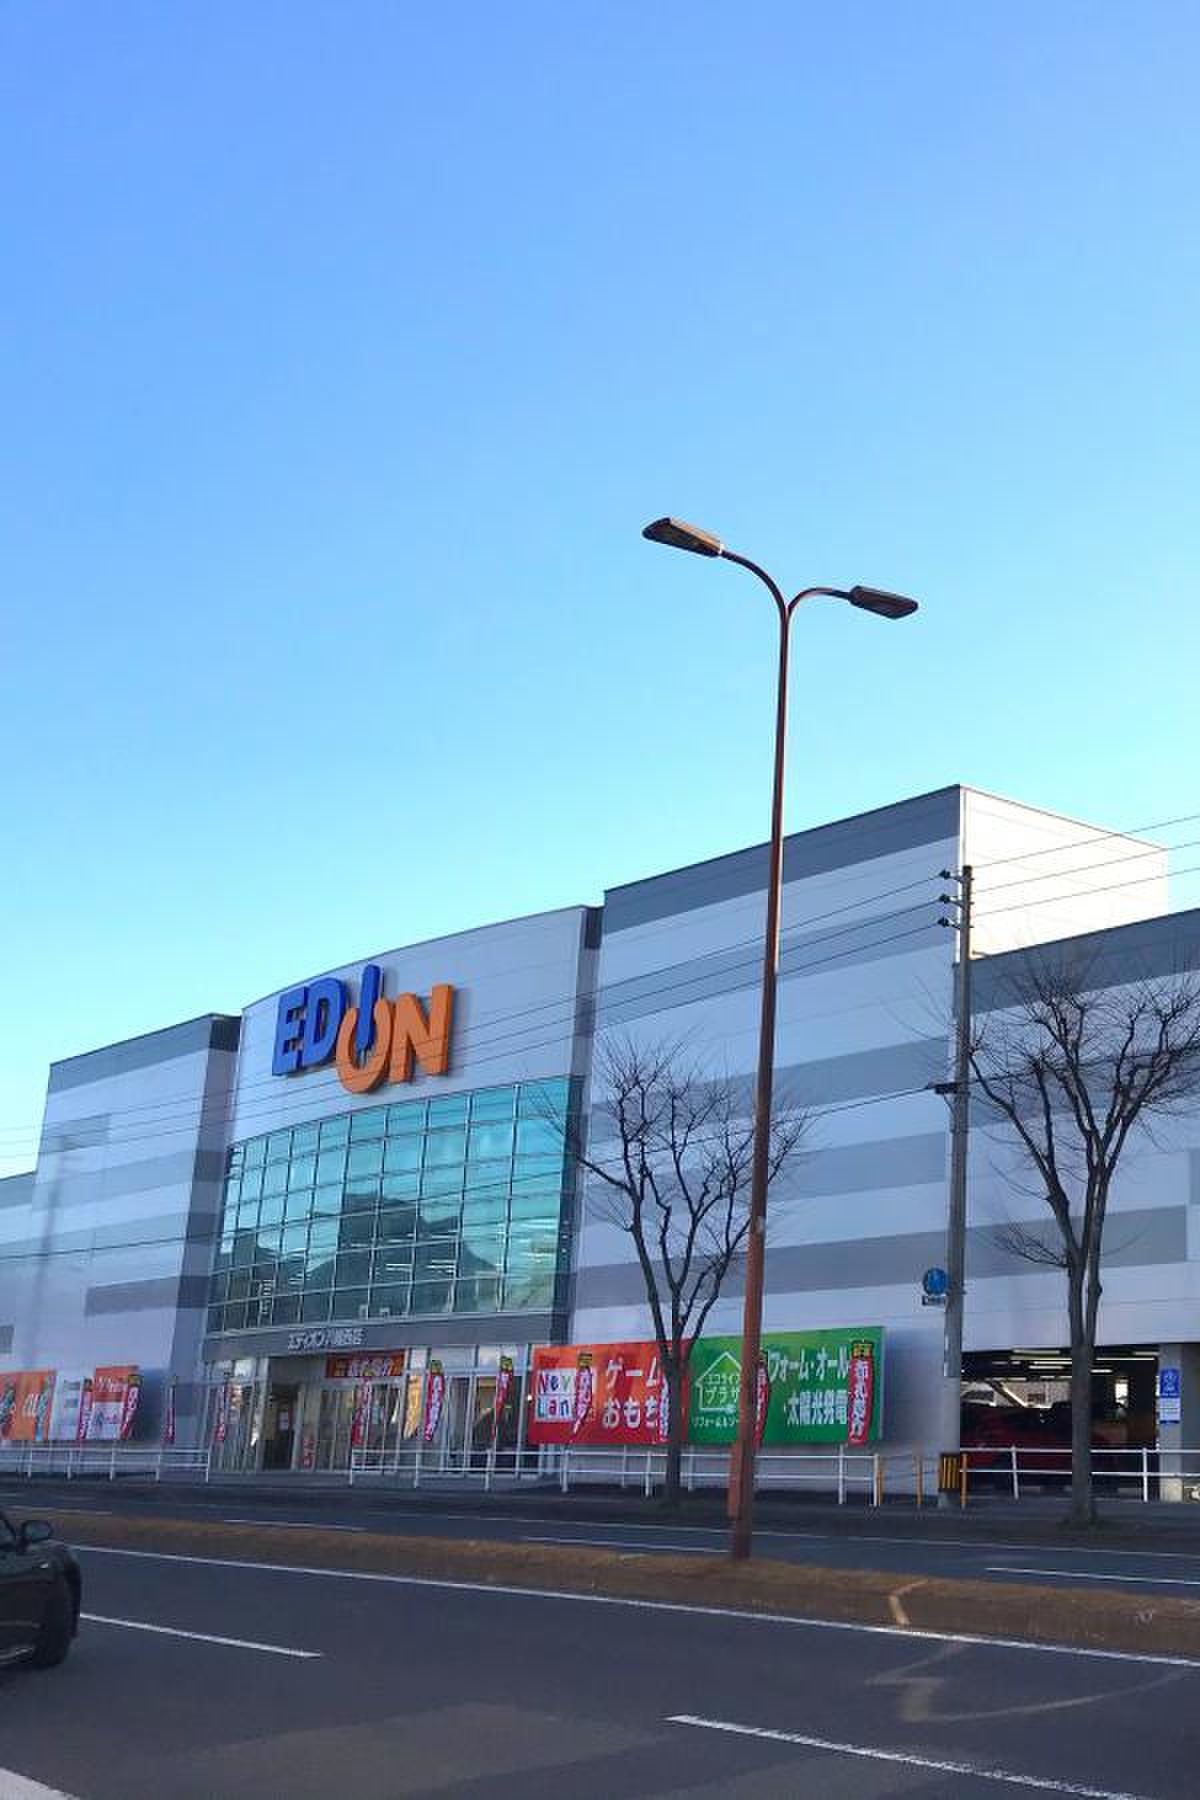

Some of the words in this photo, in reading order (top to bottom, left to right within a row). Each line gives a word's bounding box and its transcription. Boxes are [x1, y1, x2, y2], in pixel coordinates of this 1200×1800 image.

[272, 964, 455, 1094] EDION
[603, 1397, 657, 1428] おもち
